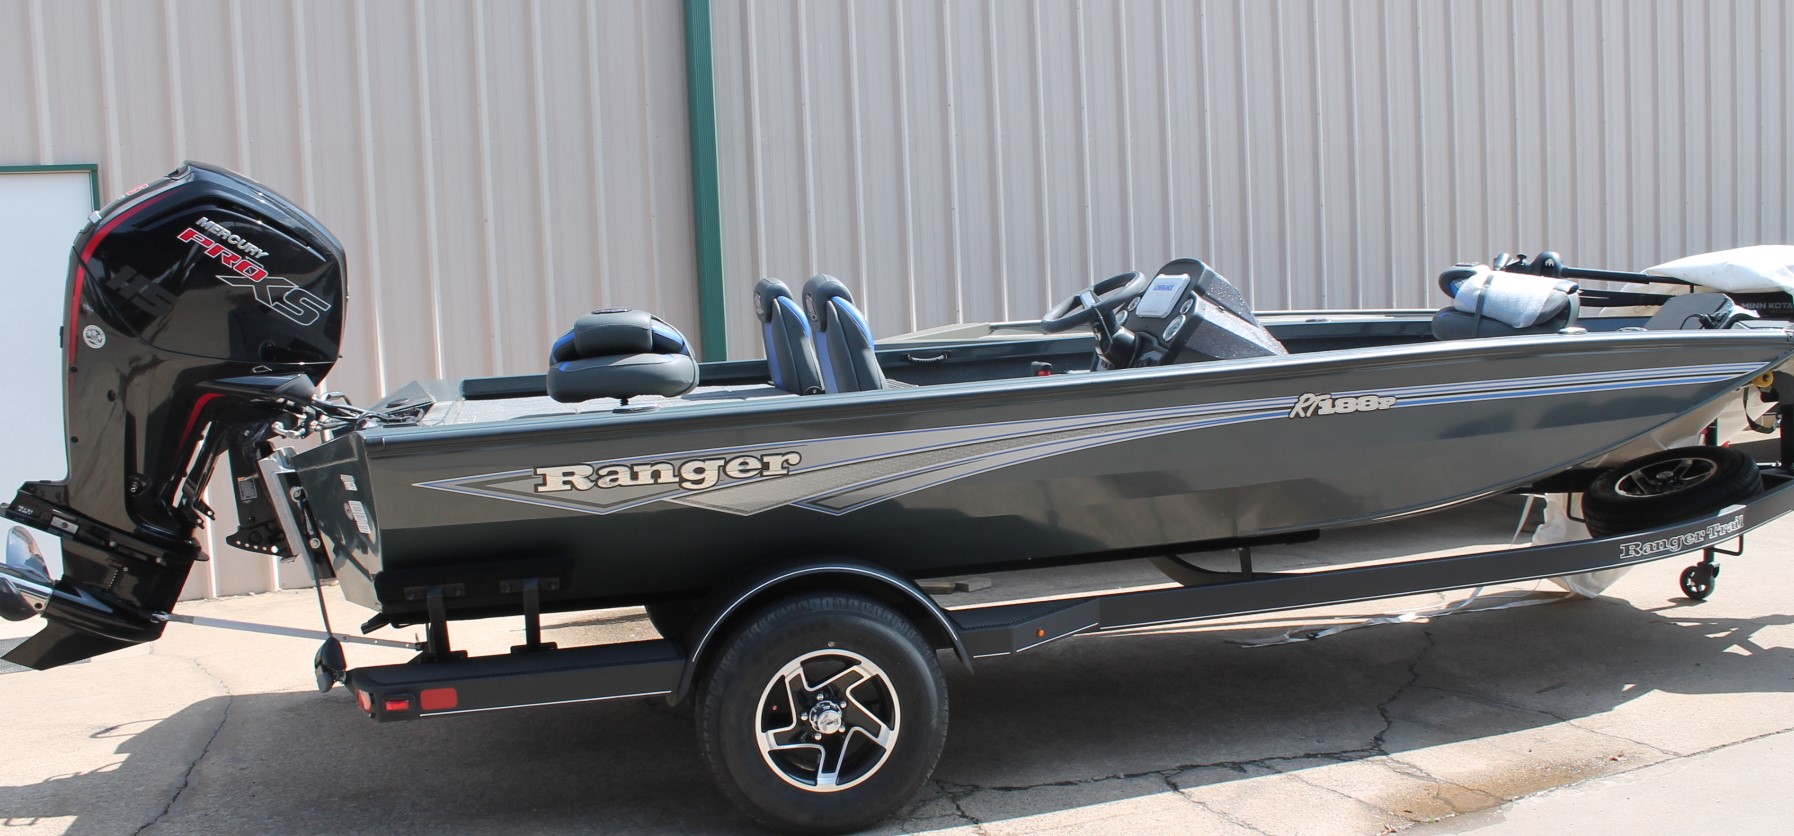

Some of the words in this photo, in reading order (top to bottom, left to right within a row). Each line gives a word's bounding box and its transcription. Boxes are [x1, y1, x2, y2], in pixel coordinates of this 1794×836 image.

[177, 227, 269, 282] PRO
[195, 216, 270, 259] MERCURY
[215, 256, 332, 326] XS
[534, 451, 802, 493] Ranger
[1620, 530, 1706, 558] Ranger
[1707, 514, 1744, 539] Trail
